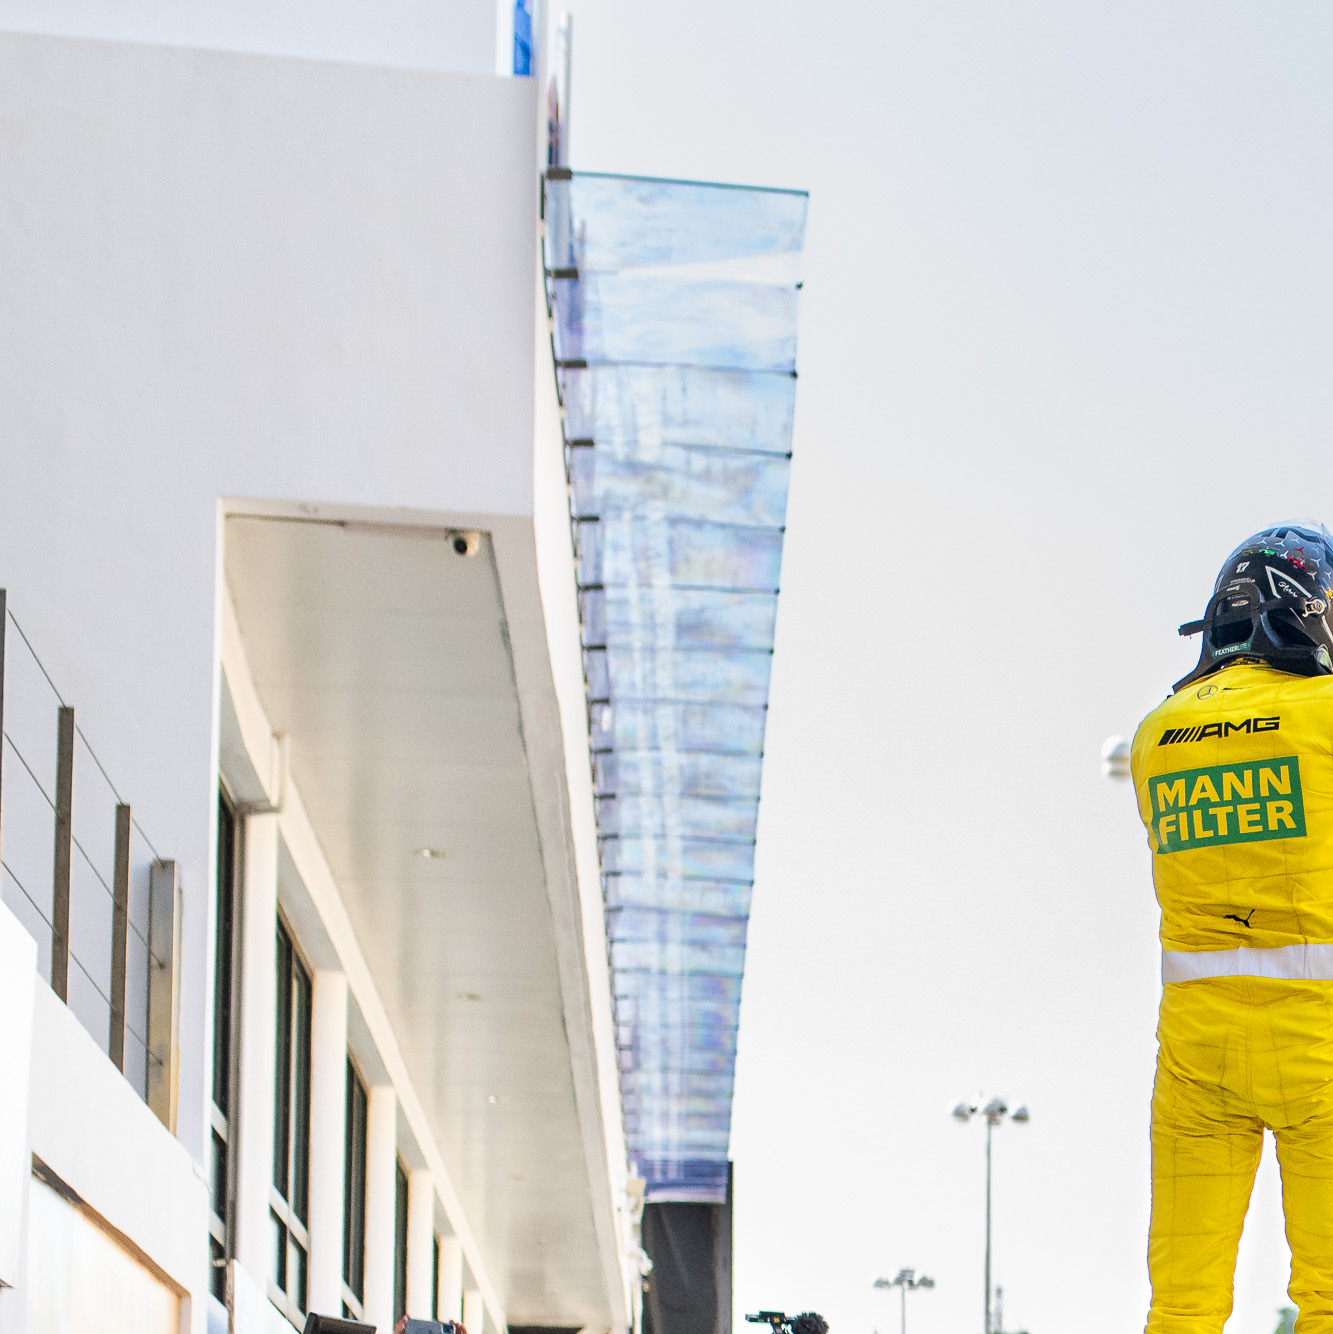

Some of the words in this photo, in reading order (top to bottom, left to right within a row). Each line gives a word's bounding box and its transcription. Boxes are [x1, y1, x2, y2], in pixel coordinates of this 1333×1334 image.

[1214, 642, 1248, 657] FEATHERLITE
[1156, 764, 1292, 813] MANN
[1158, 799, 1297, 846] FILTER
